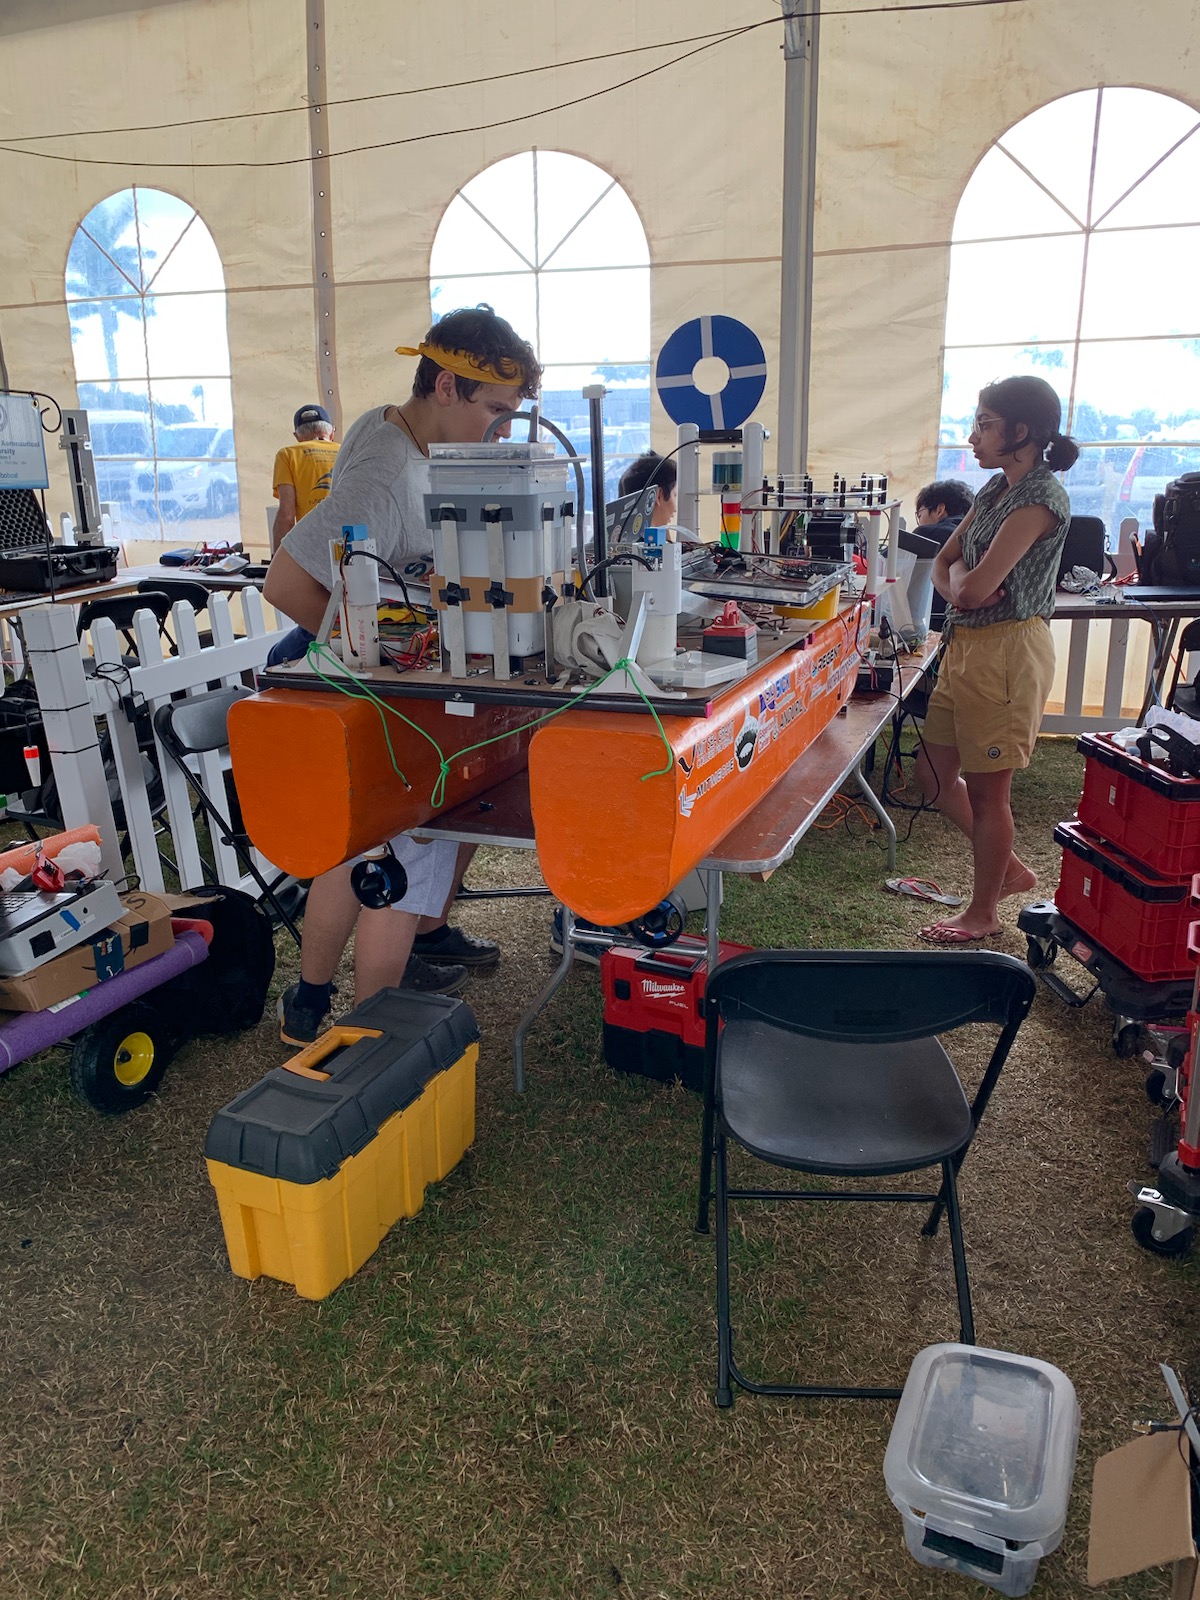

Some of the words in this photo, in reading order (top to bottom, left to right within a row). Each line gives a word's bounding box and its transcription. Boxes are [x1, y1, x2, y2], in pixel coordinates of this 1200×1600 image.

[1, 440, 40, 448] Aeronautical
[817, 642, 841, 672] REGENT
[776, 672, 790, 698] SICK
[641, 978, 686, 993] Milwaukee
[668, 1000, 689, 1009] FUEL
